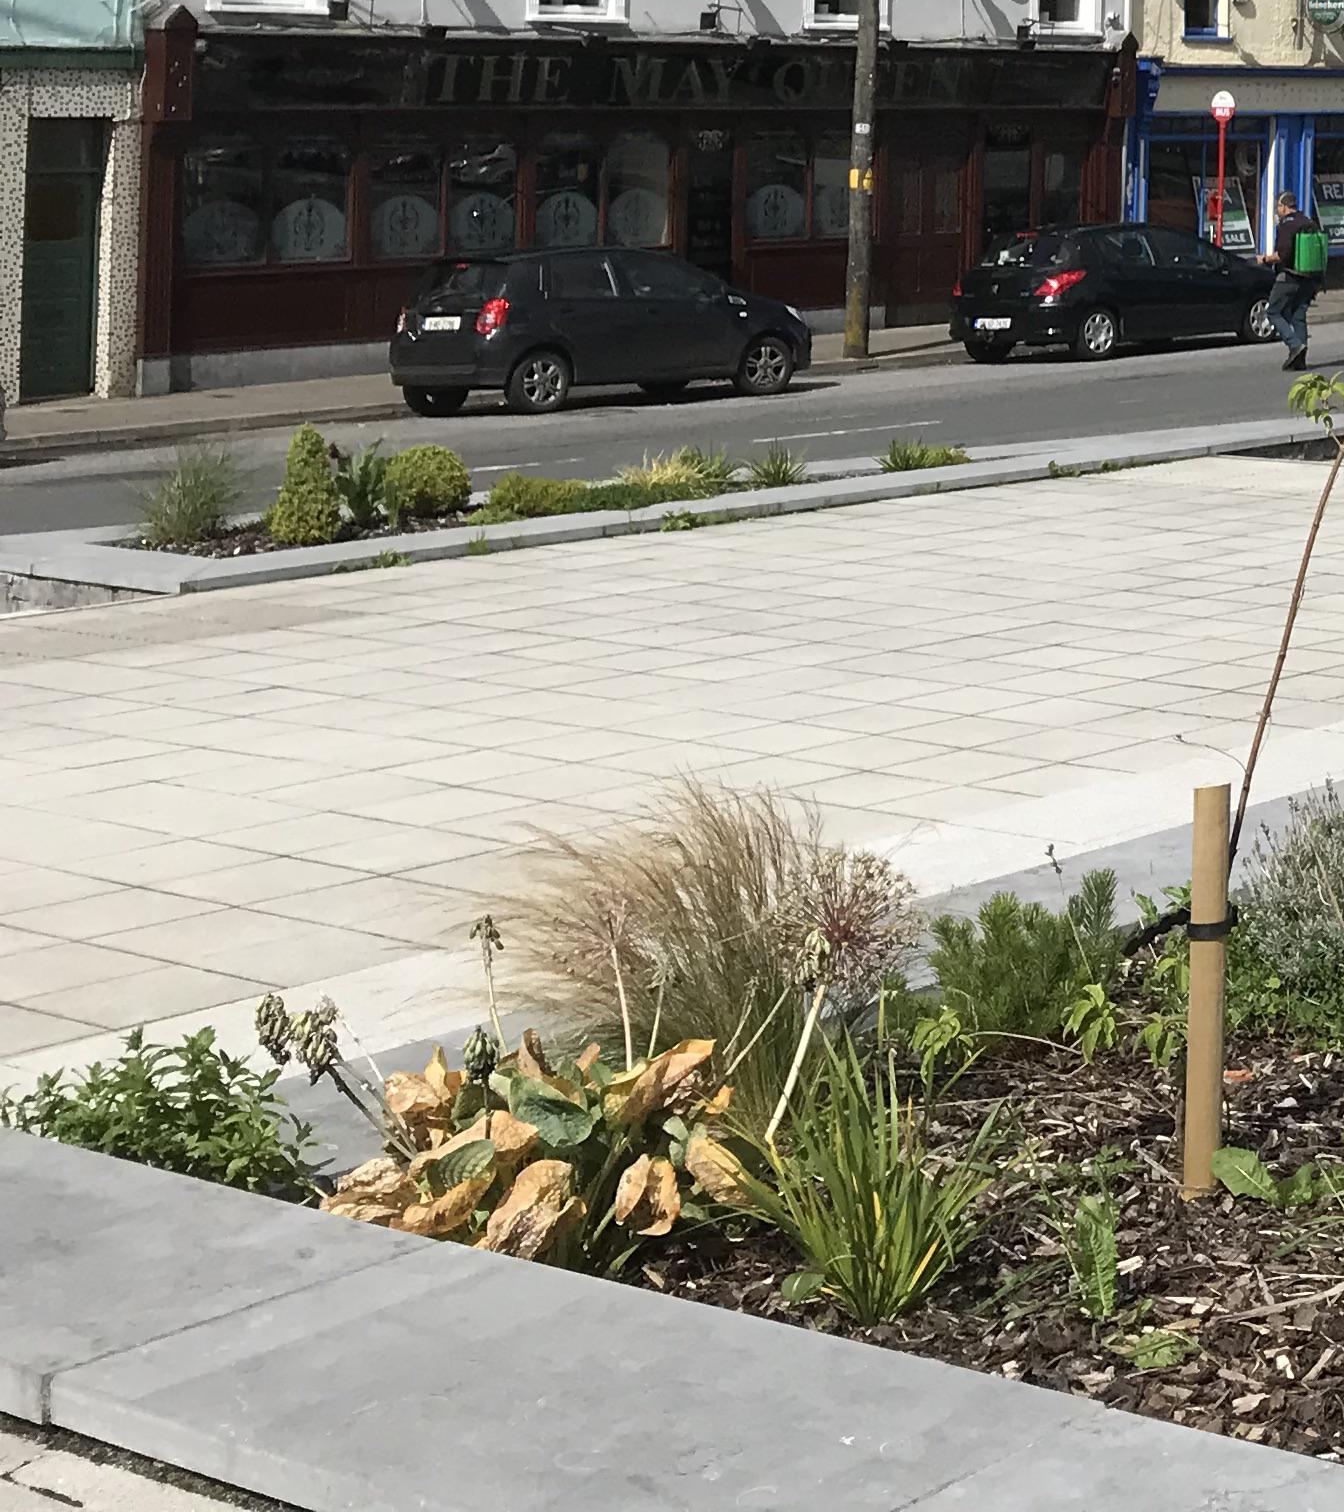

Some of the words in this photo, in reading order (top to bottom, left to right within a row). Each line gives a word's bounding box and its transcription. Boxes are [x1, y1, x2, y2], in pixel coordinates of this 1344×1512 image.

[436, 54, 572, 104] THE
[608, 55, 745, 103] MAY
[1214, 108, 1231, 117] BUS
